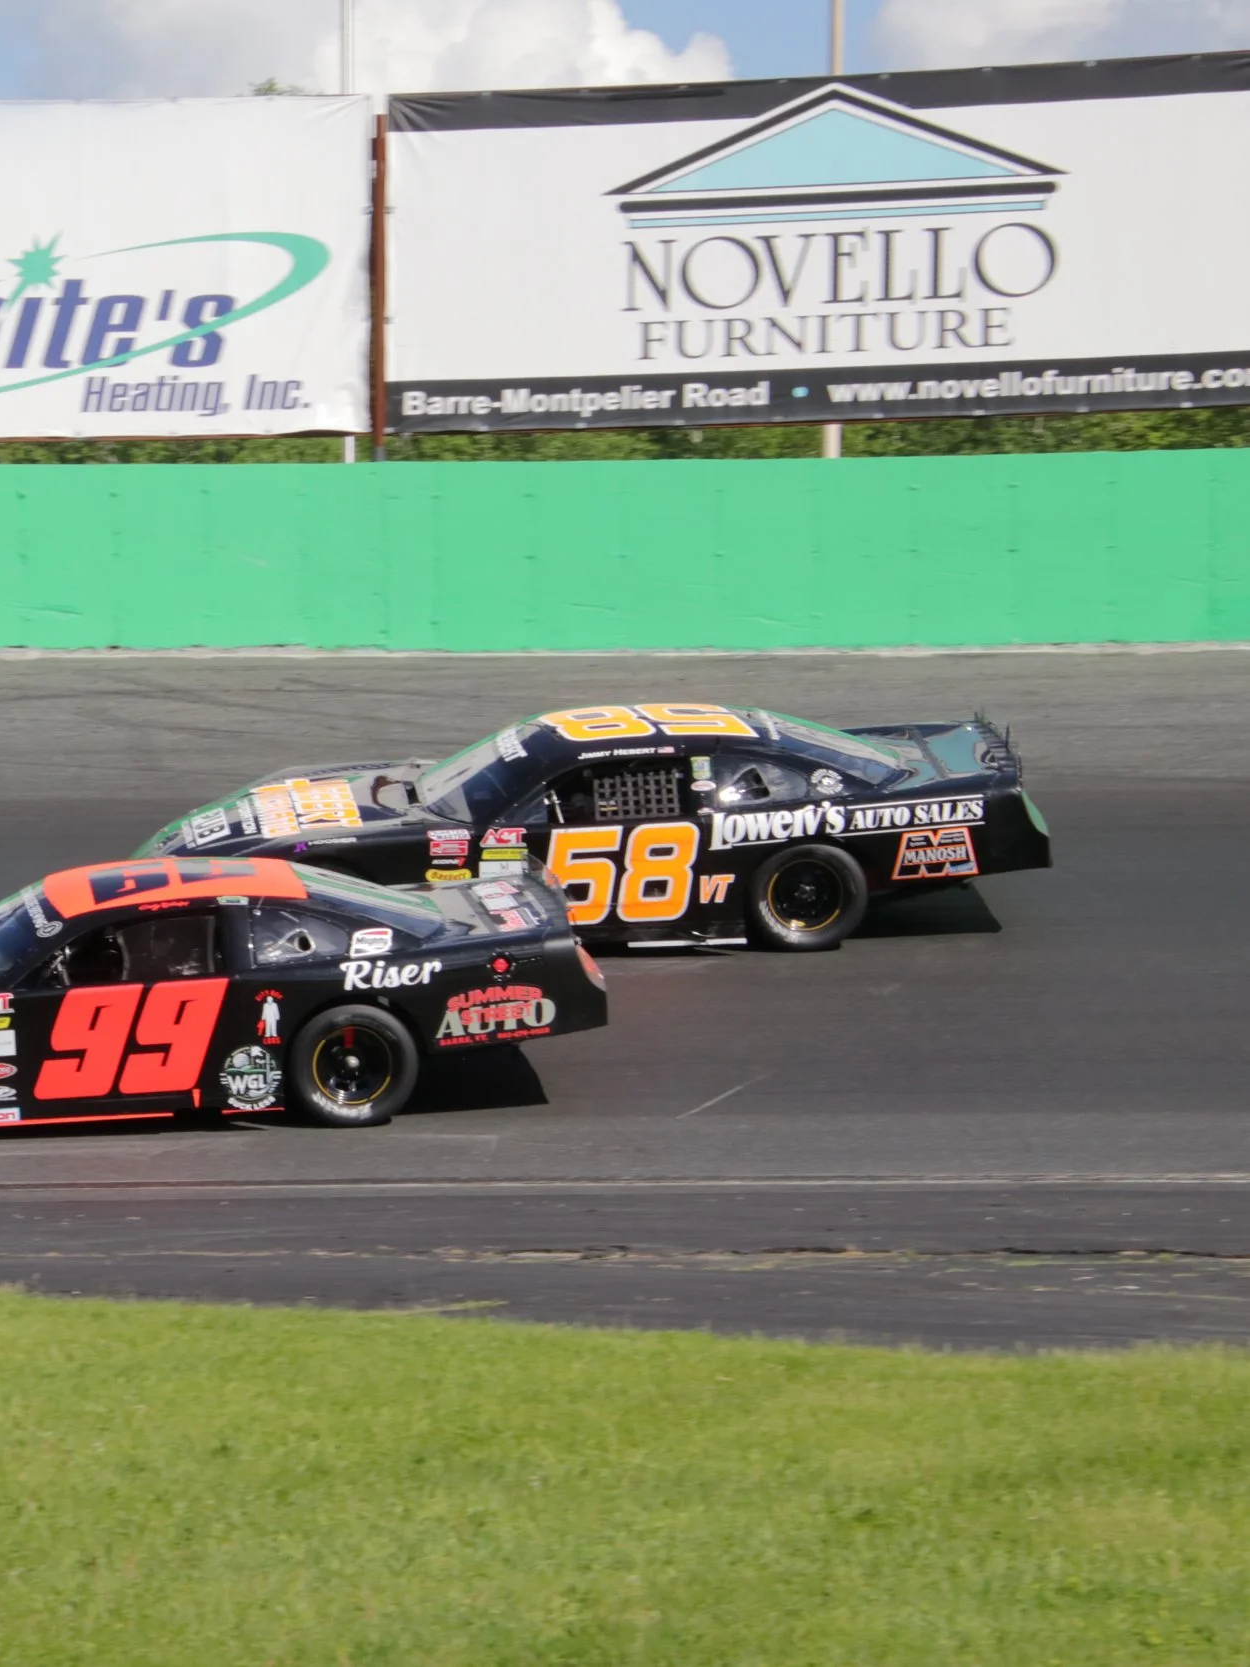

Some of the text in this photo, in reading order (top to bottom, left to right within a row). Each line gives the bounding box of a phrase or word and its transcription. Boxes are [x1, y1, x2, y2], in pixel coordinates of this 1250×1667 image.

[620, 222, 1058, 312] NOVELLO
[637, 307, 1014, 361] FURNITURE
[82, 374, 311, 417] Heating, Inc.
[402, 380, 770, 418] Barre-Montpelier Road
[849, 805, 911, 831] AUTO
[913, 799, 985, 825] SALES
[308, 836, 358, 846] HOOSIER
[903, 845, 968, 864] MANOSH
[546, 821, 700, 925] 58
[698, 873, 735, 904] VT
[339, 959, 443, 991] Riser
[447, 985, 543, 1013] SUMMER
[460, 1003, 534, 1026] STREET
[435, 997, 556, 1039] AUTO
[34, 977, 230, 1100] 99
[225, 1073, 268, 1095] WGL
